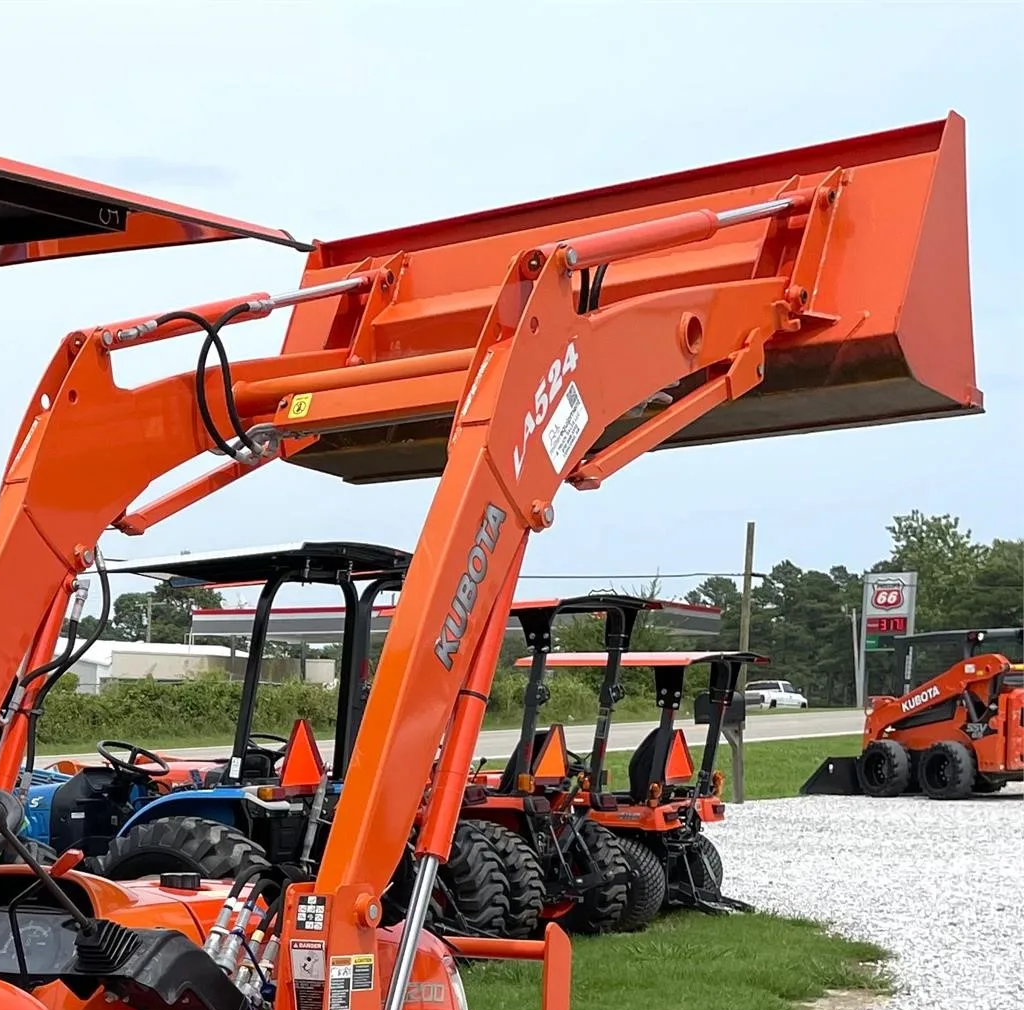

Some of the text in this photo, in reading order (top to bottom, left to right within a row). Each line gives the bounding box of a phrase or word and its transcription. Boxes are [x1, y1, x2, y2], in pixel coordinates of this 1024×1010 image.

[513, 341, 579, 482] LA524
[434, 503, 507, 671] KUBOTA
[876, 591, 898, 605] 66
[901, 685, 940, 713] KUBOTA
